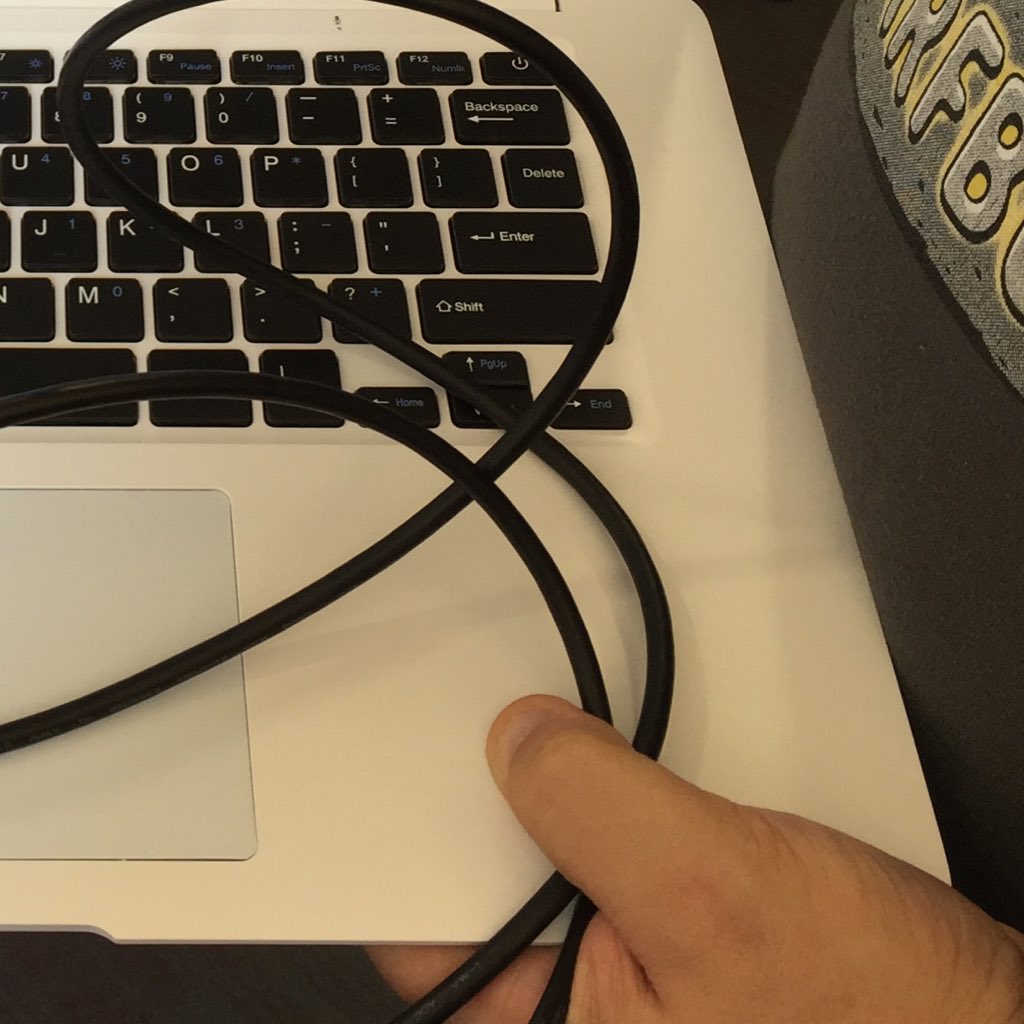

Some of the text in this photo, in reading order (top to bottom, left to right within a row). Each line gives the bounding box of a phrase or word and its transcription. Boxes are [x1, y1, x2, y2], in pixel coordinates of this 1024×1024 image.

[159, 53, 213, 71] F9 Pause
[242, 54, 264, 62] F10
[326, 54, 346, 63] F11
[409, 55, 429, 63] F12
[464, 101, 539, 114] Backspace
[136, 112, 147, 123] 9
[11, 154, 28, 171] U
[264, 155, 280, 172] P
[522, 168, 565, 179] Delete
[34, 219, 48, 236] J
[119, 219, 137, 236] K
[499, 231, 535, 243] Enter
[78, 286, 99, 304] M
[454, 302, 485, 313] Shift
[395, 397, 424, 408] Home
[589, 399, 612, 410] End
